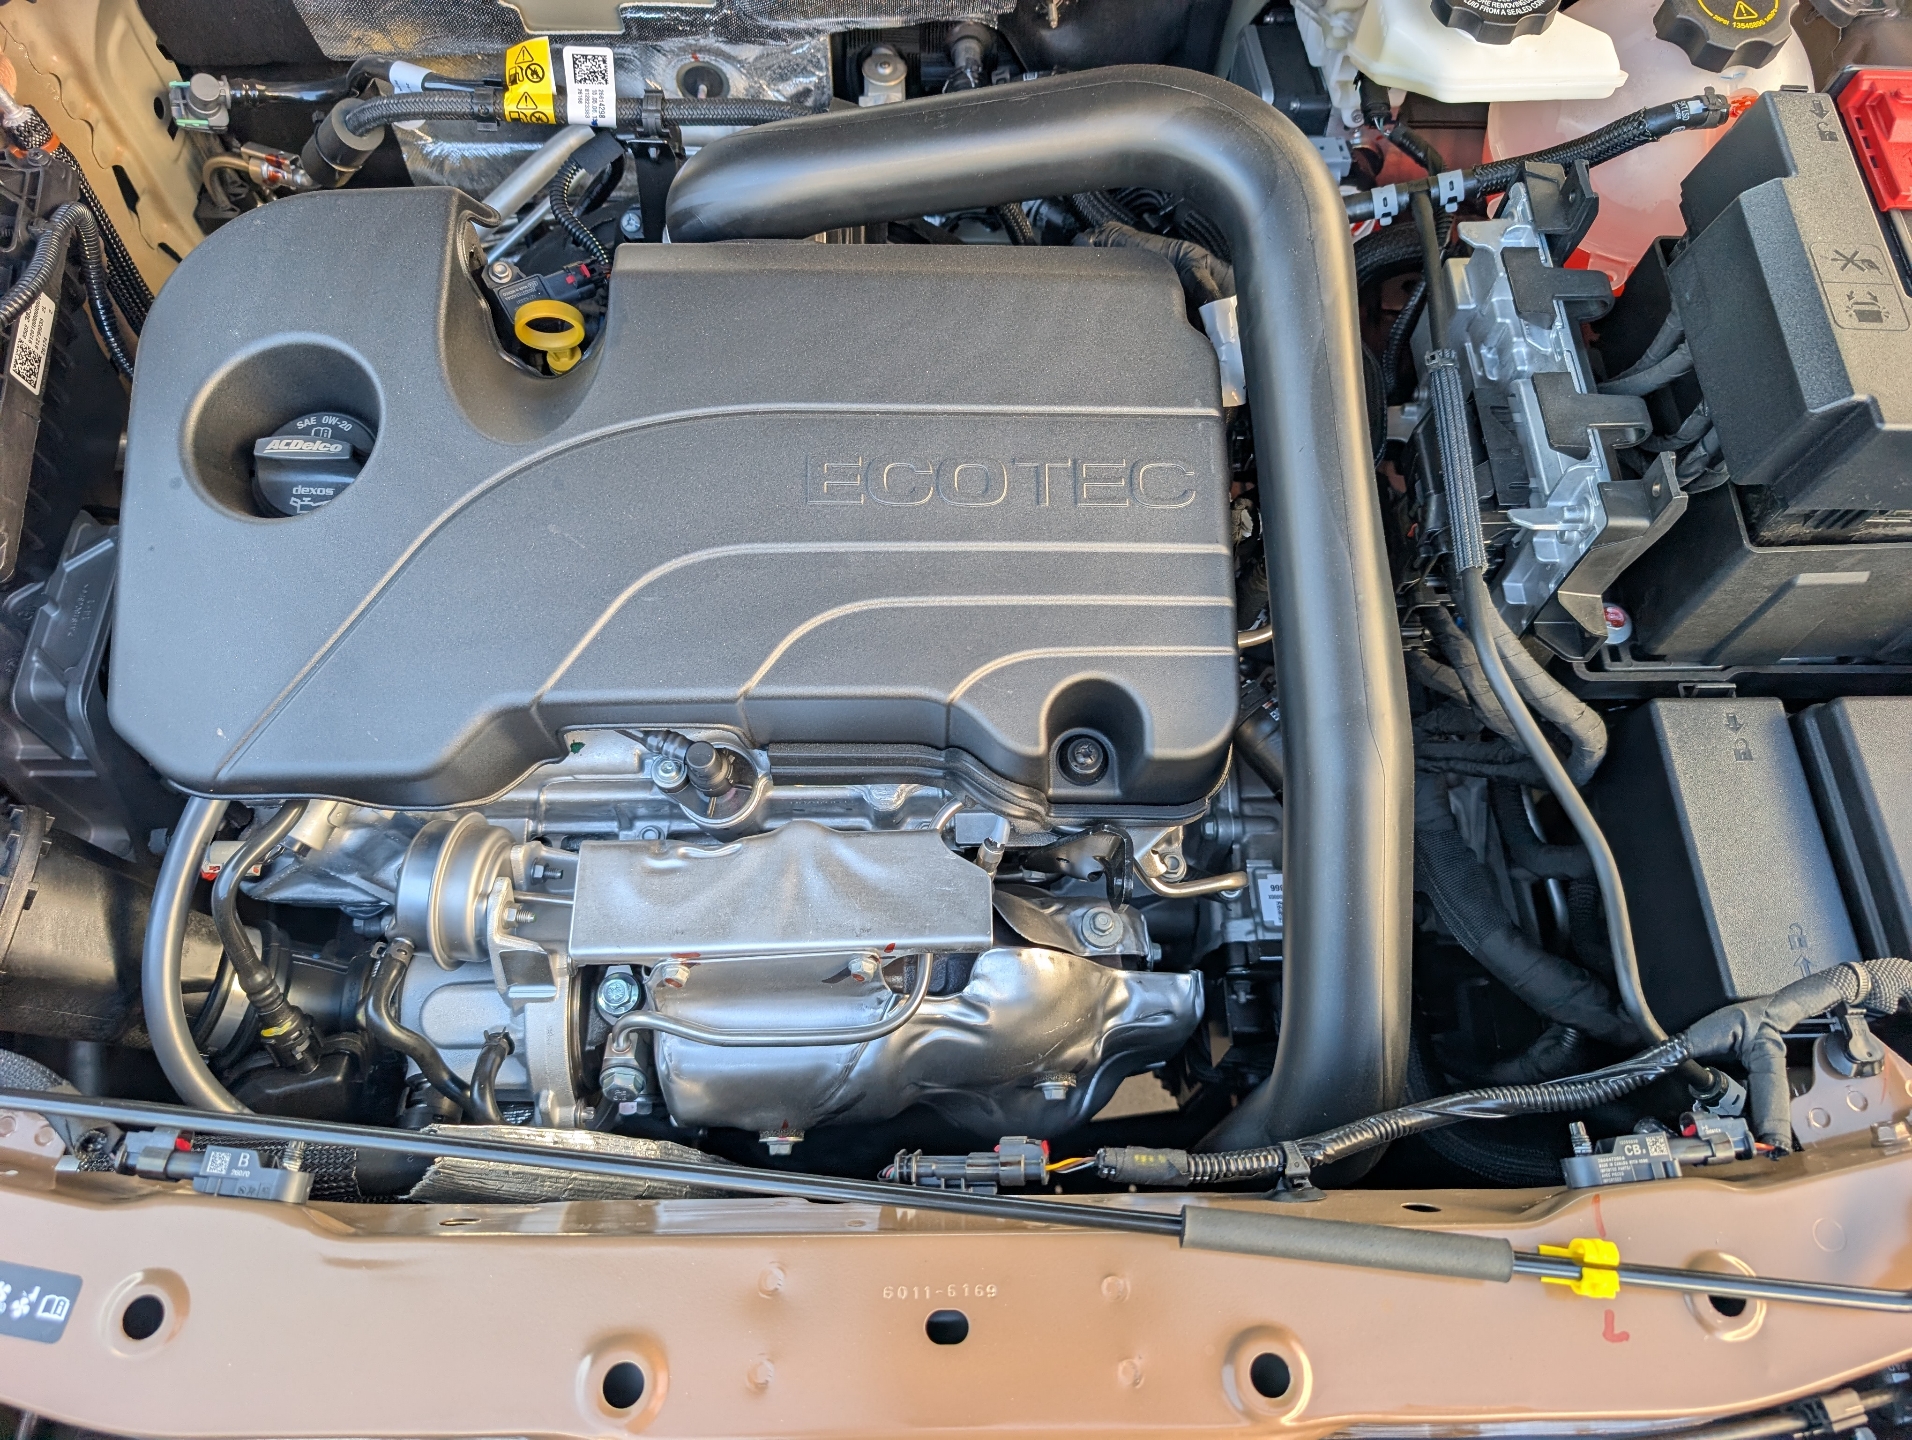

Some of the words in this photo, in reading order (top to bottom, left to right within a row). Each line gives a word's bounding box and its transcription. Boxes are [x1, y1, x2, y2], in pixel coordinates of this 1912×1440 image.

[1463, 0, 1479, 8] LUID
[1479, 4, 1500, 15] FROM
[1506, 5, 1533, 16] SEALED
[296, 416, 317, 430] SAE
[322, 415, 353, 432] 0W-20
[264, 439, 343, 453] ACDelco
[806, 455, 1196, 509] ECOTEC
[292, 485, 335, 496] dexos
[1624, 1144, 1641, 1156] CB
[238, 1152, 250, 1167] B
[883, 1283, 998, 1299] 6011-6169
